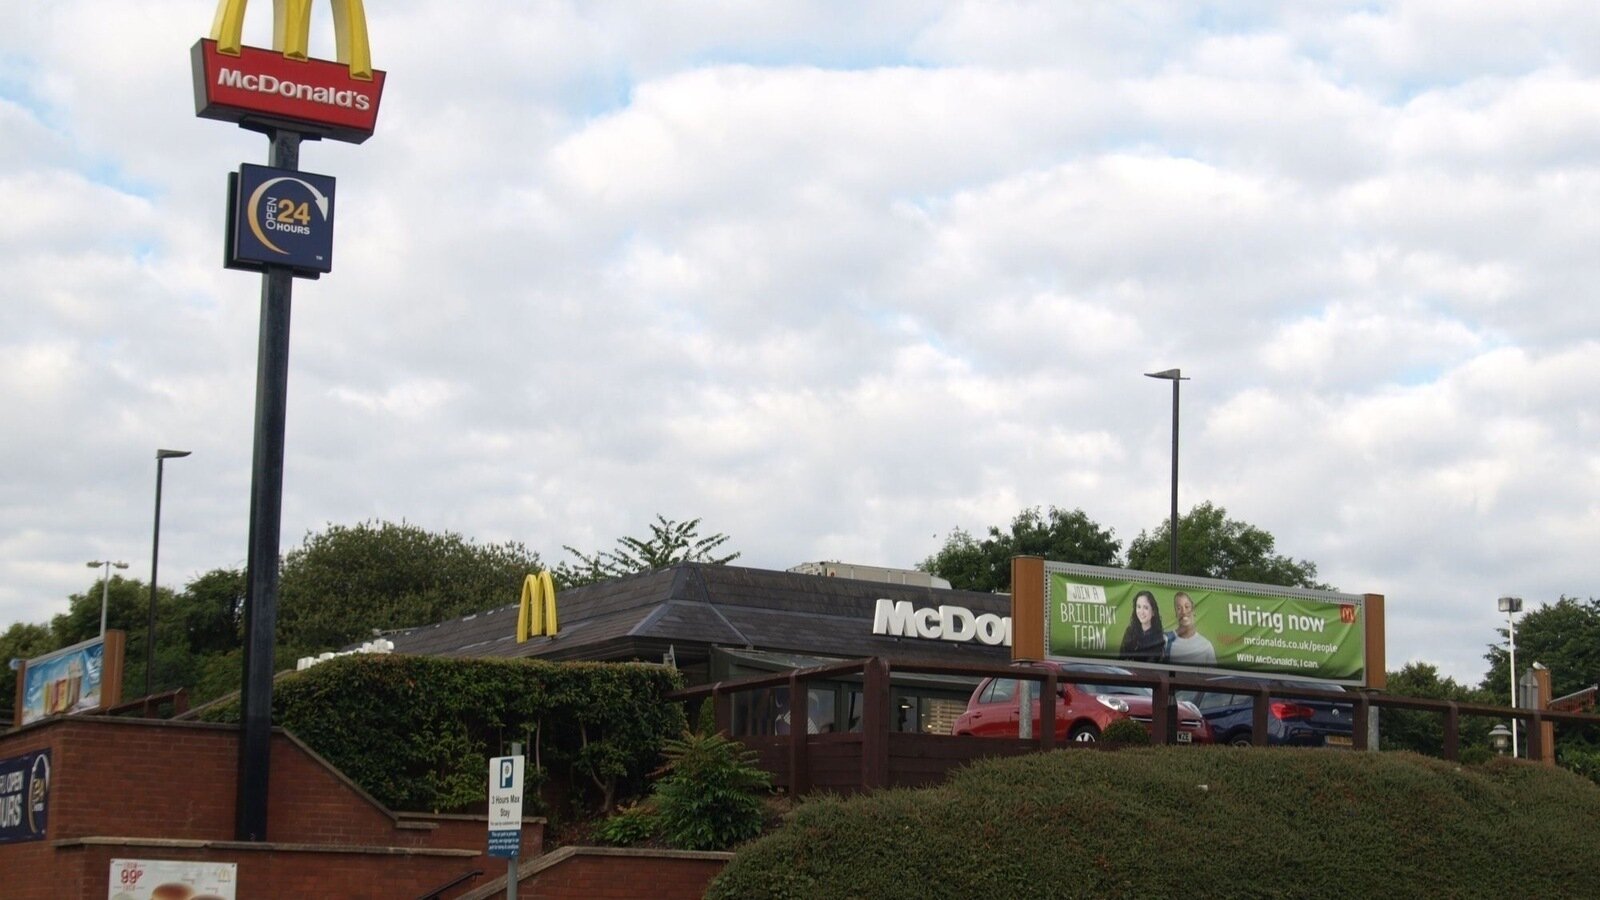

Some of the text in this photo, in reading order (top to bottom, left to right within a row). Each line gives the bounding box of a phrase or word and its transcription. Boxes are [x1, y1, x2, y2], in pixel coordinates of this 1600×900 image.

[217, 67, 370, 111] McDonald's
[265, 196, 278, 230] OPEN
[277, 199, 311, 225] 24
[276, 223, 311, 235] HOURS
[1092, 586, 1100, 600] A
[1060, 602, 1117, 625] BRILLIANT
[1228, 603, 1326, 634] Hiring now
[1072, 624, 1106, 650] TEAM
[1243, 635, 1338, 654] mcdonalds.co.uk/people
[1236, 652, 1255, 663] With
[495, 795, 510, 804] Hours
[510, 794, 520, 804] Max
[500, 808, 511, 819] Stay
